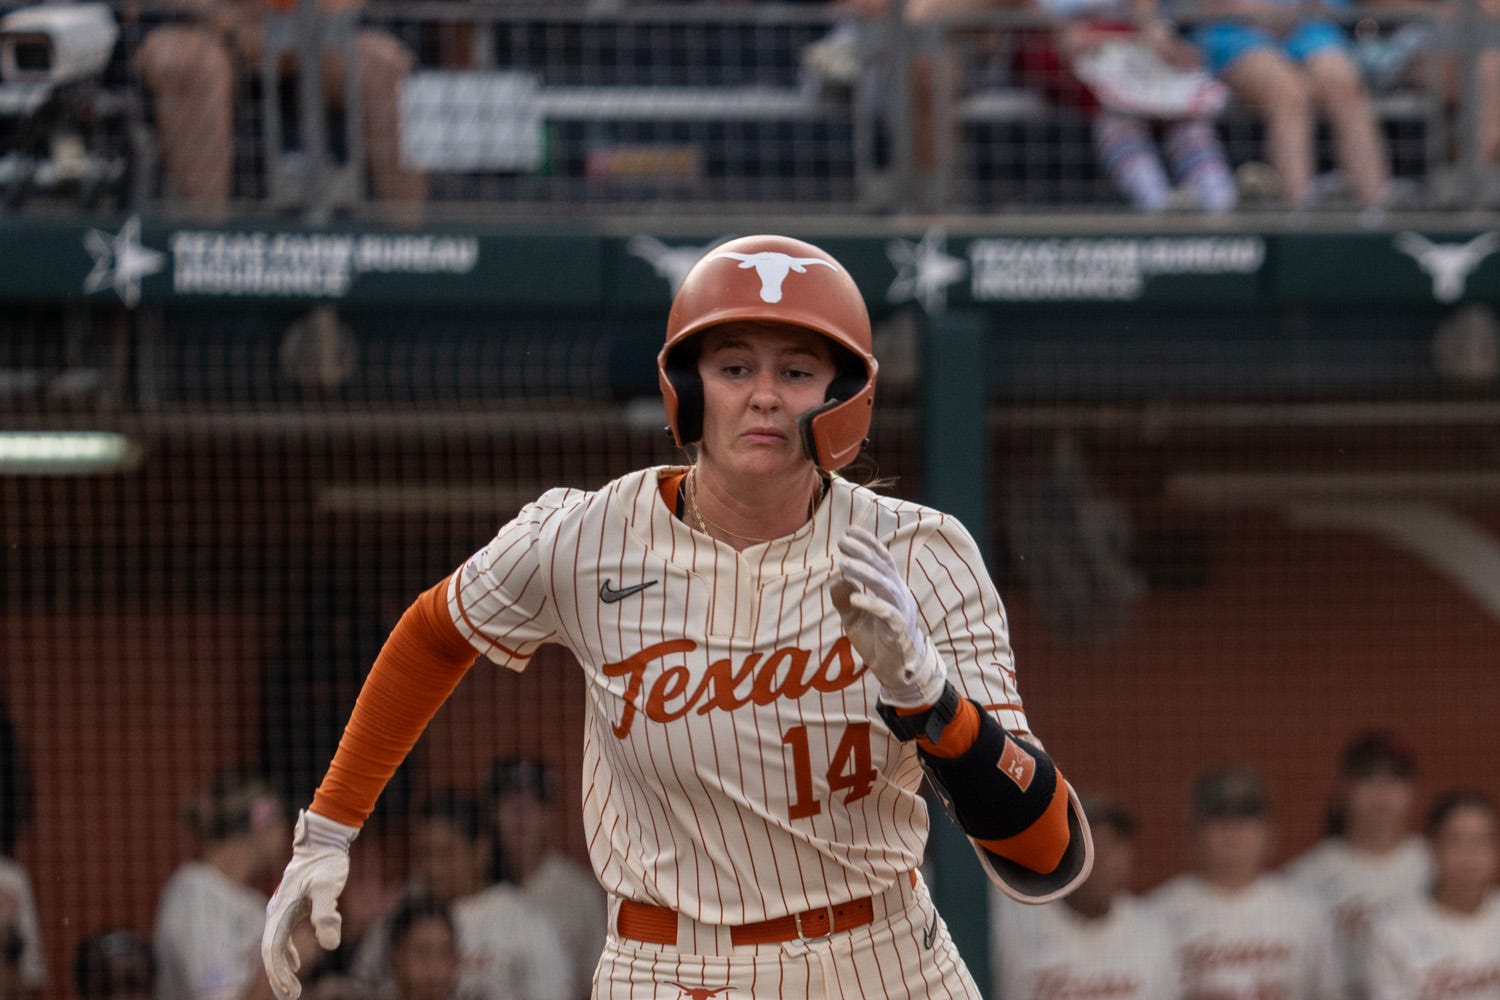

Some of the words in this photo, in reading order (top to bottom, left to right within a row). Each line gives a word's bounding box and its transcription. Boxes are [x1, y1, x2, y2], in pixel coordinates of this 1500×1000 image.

[602, 636, 868, 740] Texas
[782, 722, 878, 820] 14
[1007, 759, 1024, 780] 14
